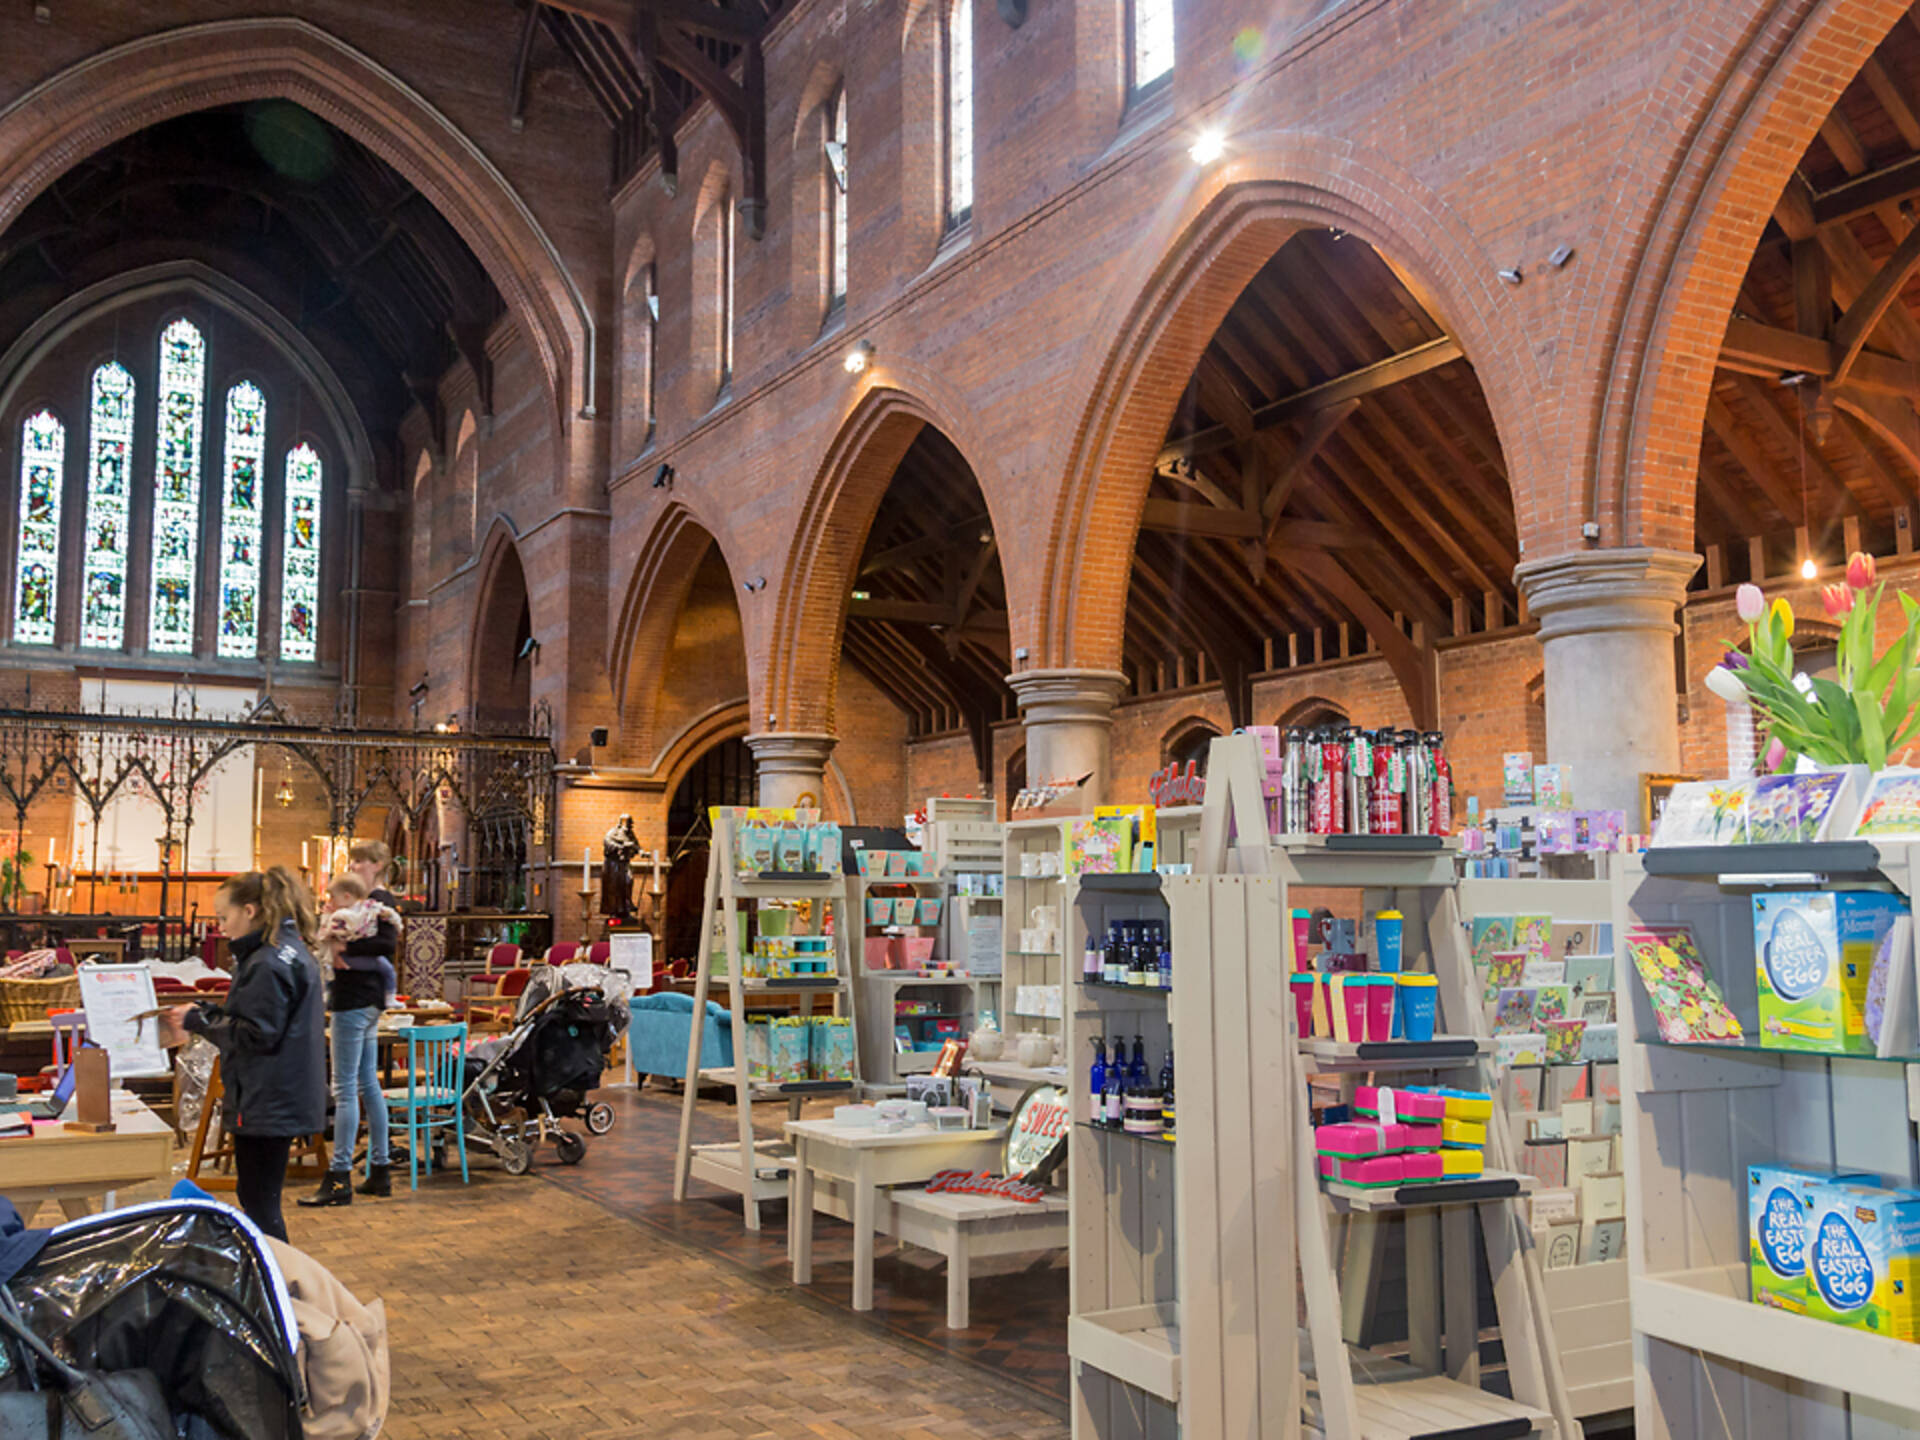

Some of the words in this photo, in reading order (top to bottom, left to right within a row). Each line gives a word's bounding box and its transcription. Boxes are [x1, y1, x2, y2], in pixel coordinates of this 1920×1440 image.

[1777, 918, 1800, 935] THE
[1775, 931, 1815, 953] REAL
[1771, 946, 1825, 971] EASTER
[1782, 963, 1822, 987] EGG
[1771, 1199, 1795, 1212] THE
[1824, 1225, 1848, 1239] THE
[1822, 1239, 1861, 1257] REAL
[1818, 1257, 1870, 1276] EASTER
[1829, 1275, 1867, 1296] EGG
